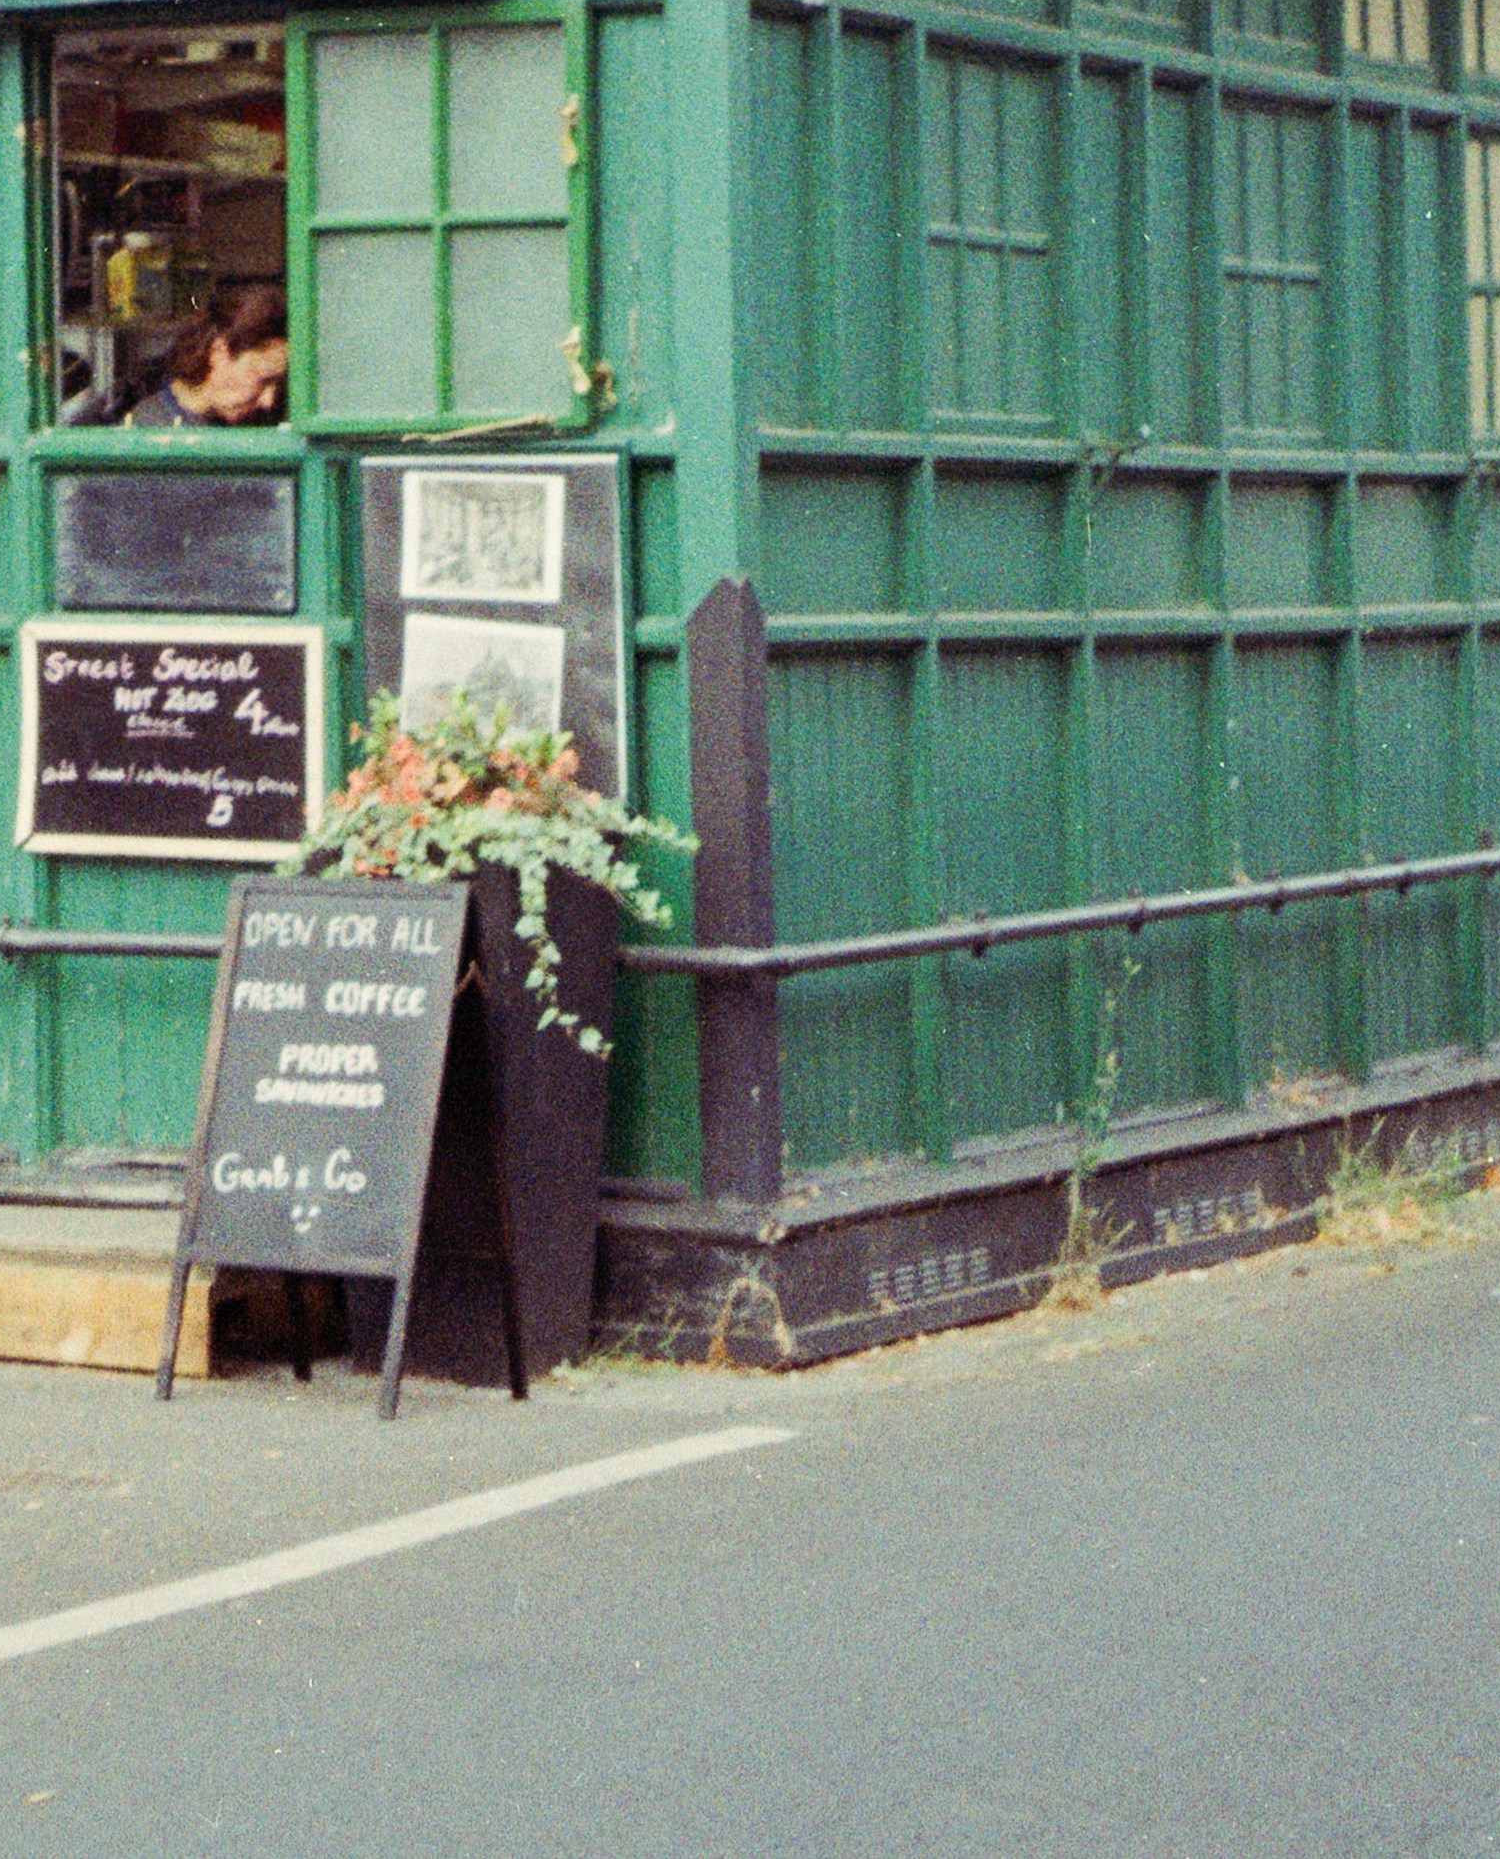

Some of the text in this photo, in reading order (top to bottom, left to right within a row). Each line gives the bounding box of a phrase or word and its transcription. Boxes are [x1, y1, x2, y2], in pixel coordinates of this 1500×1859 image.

[245, 912, 442, 955] OPEN FOR ALL
[234, 980, 427, 1017] FRESH COFFEE
[278, 1044, 378, 1076] PROPER
